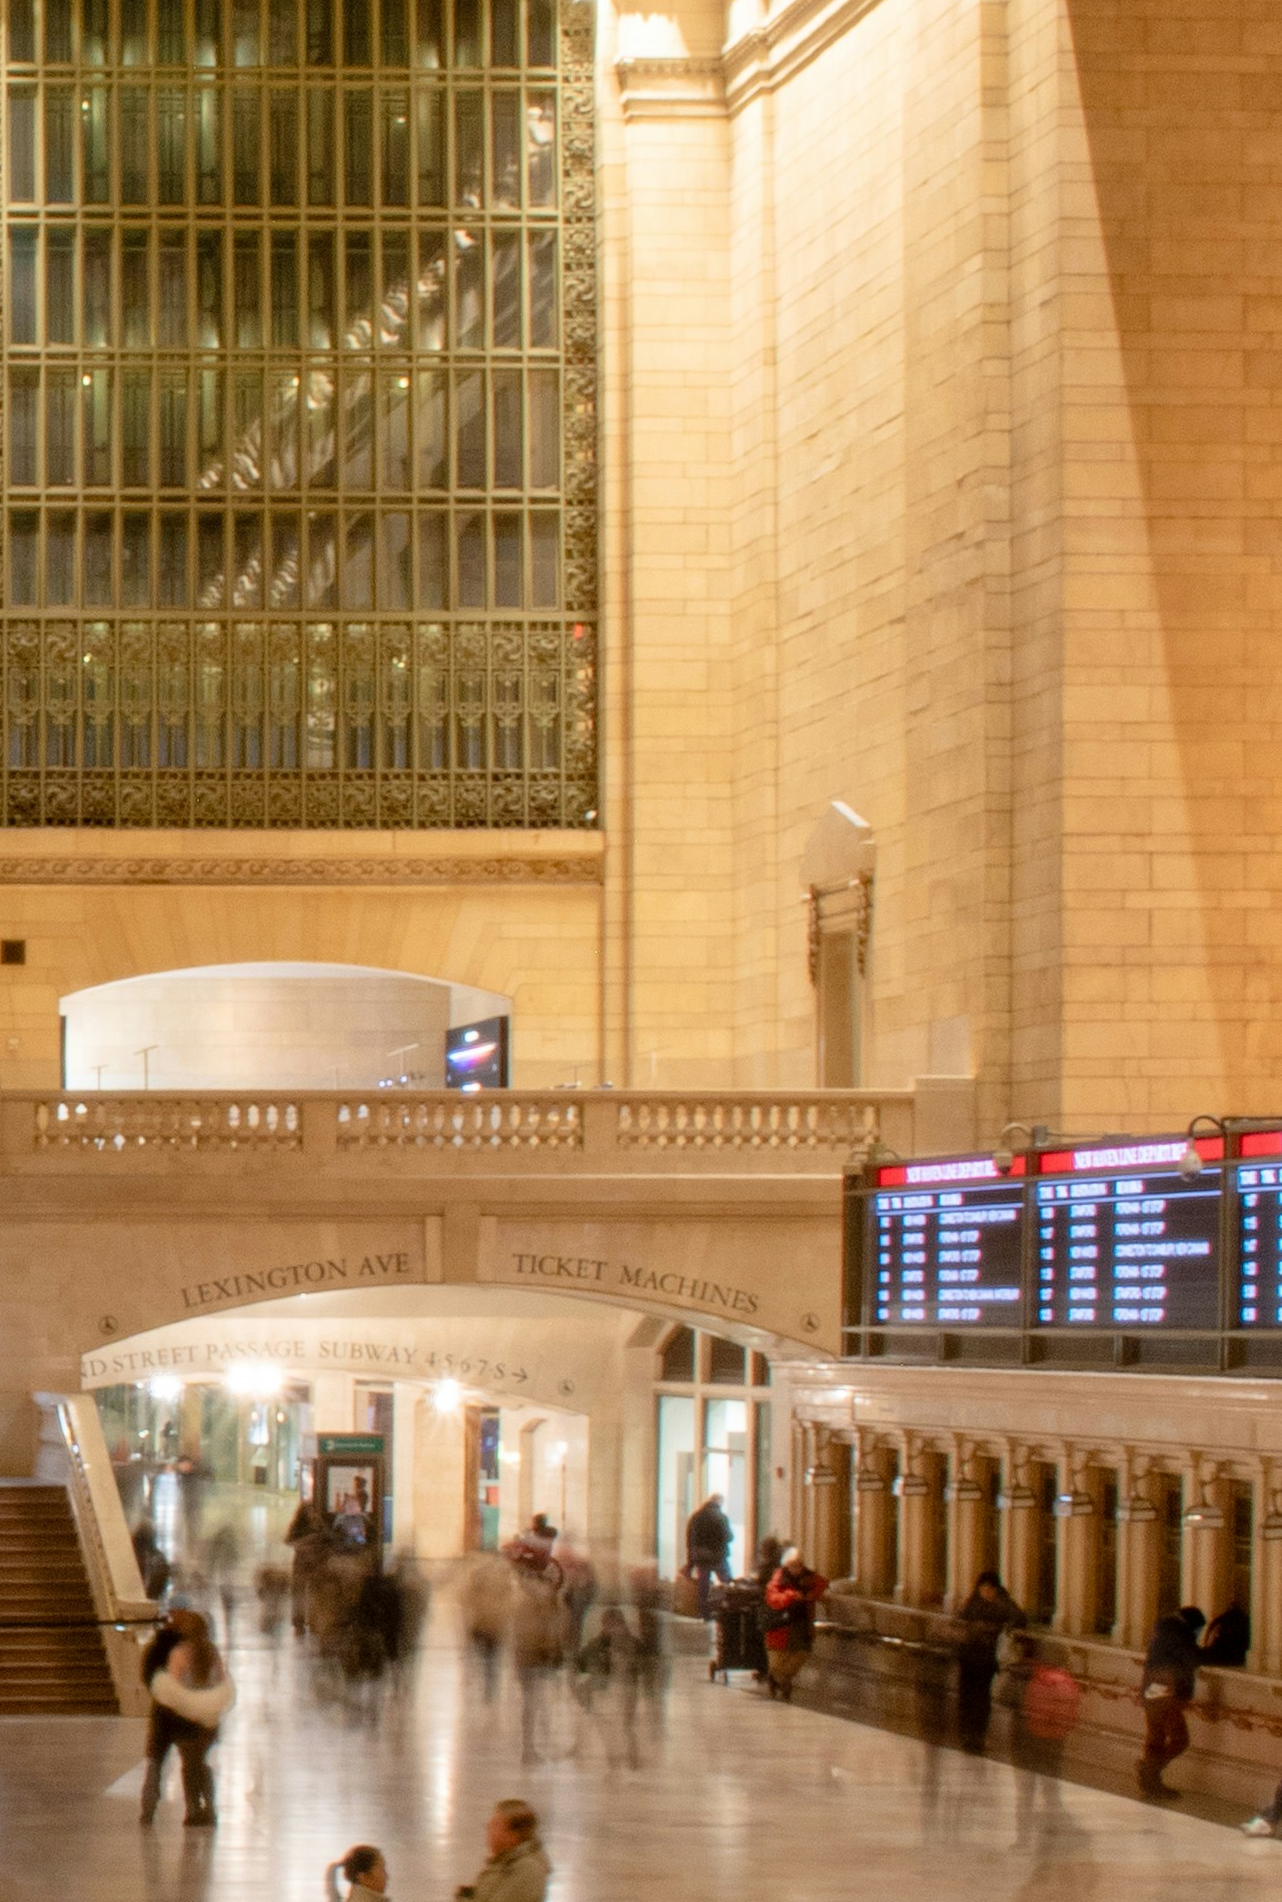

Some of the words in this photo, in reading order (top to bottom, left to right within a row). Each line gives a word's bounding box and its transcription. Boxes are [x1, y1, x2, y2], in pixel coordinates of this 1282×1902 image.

[181, 1258, 347, 1308] LEXINGTON
[358, 1252, 410, 1276] AVE
[513, 1253, 608, 1281] TICKET
[619, 1264, 759, 1314] MACHINES
[112, 1346, 198, 1374] STREET
[205, 1340, 306, 1362] PASSAGE
[318, 1341, 418, 1365] SUBWAY
